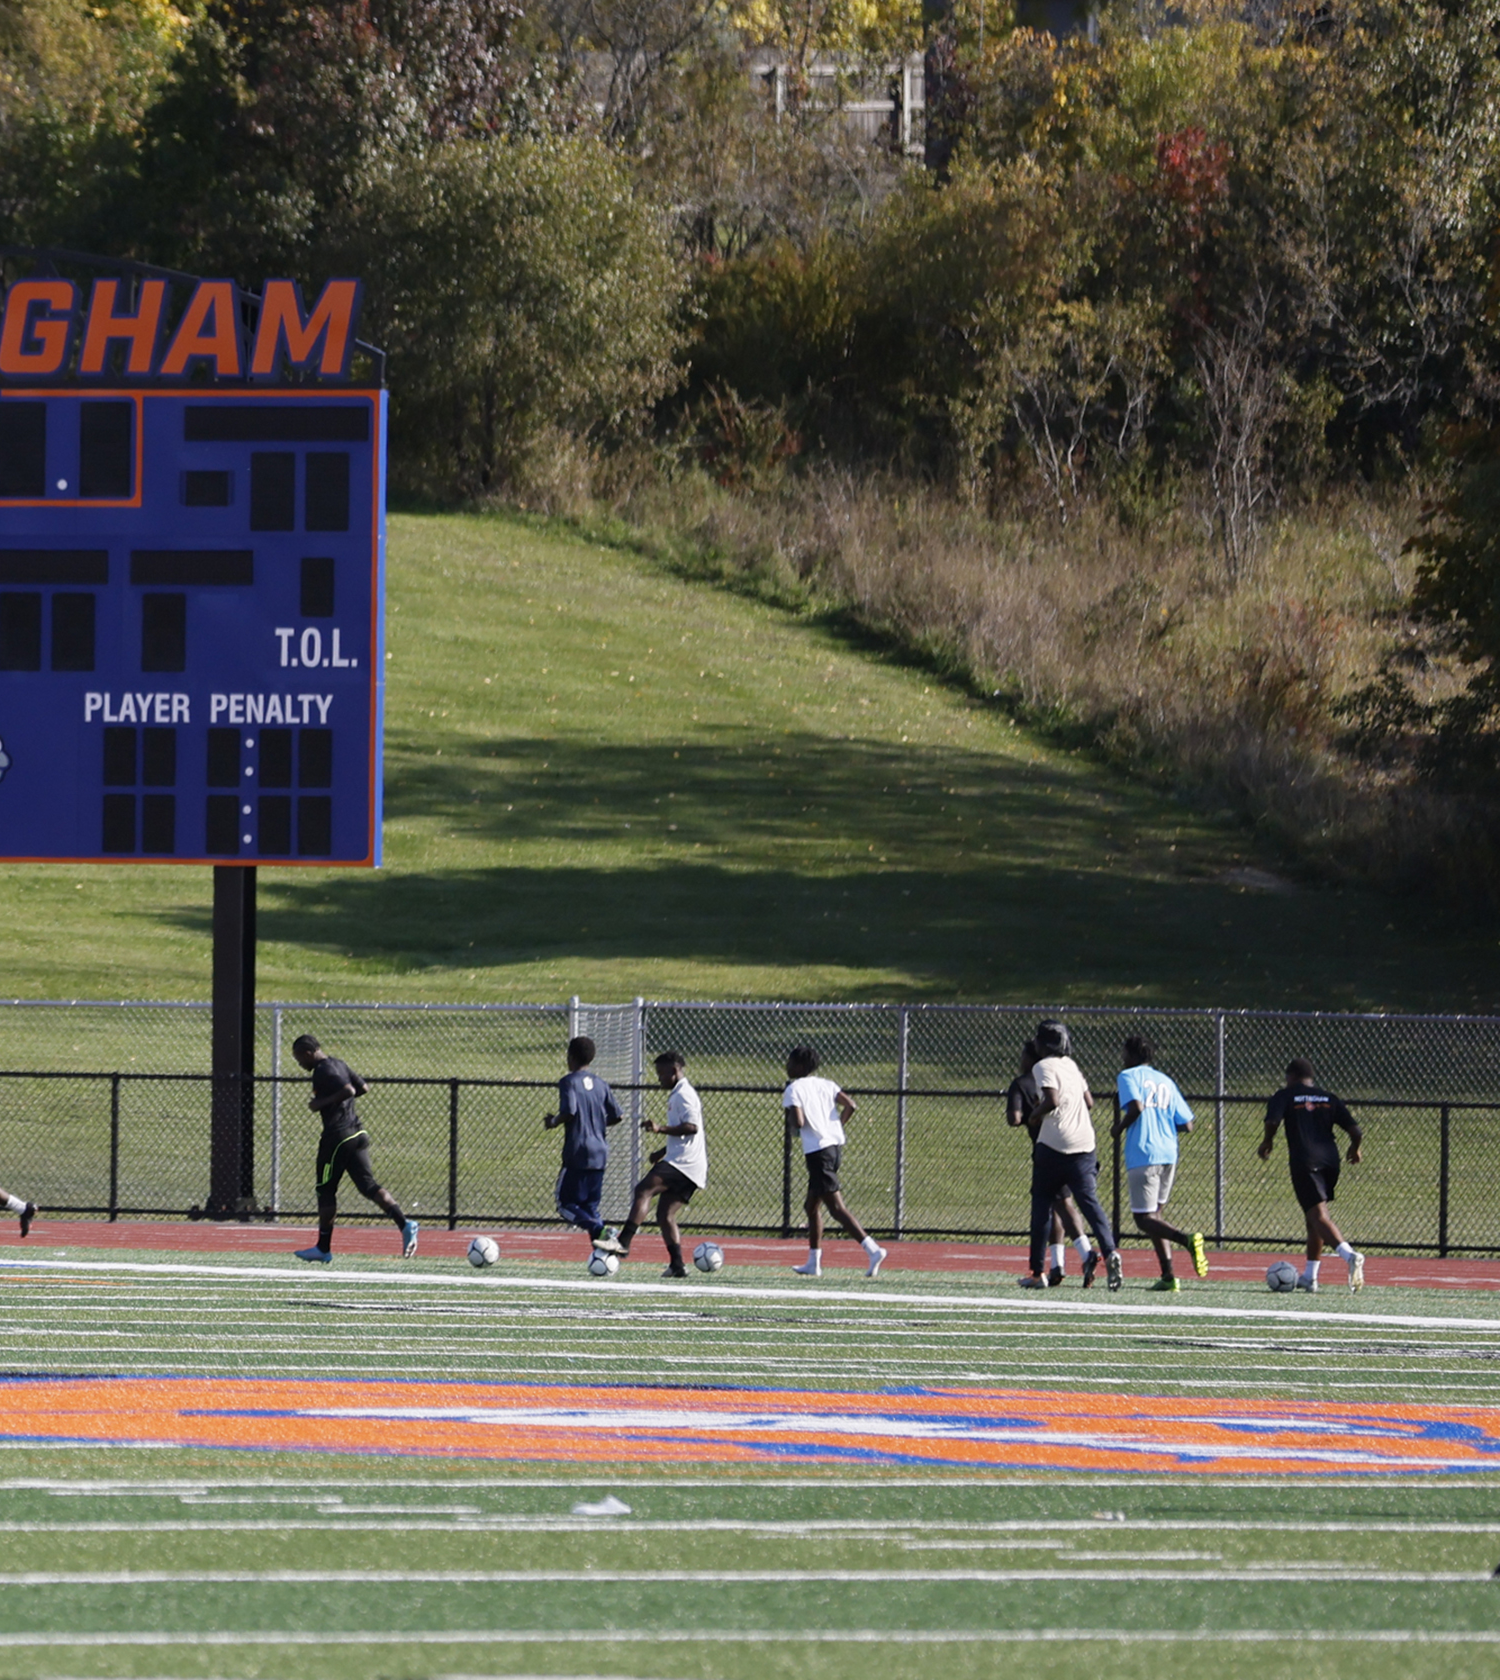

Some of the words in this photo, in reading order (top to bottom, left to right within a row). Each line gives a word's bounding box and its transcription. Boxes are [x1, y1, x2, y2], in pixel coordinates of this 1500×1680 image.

[275, 627, 358, 668] T.O.L.
[85, 692, 190, 722] PLAYER
[211, 693, 334, 724] PENALTY
[1143, 1080, 1171, 1110] 20
